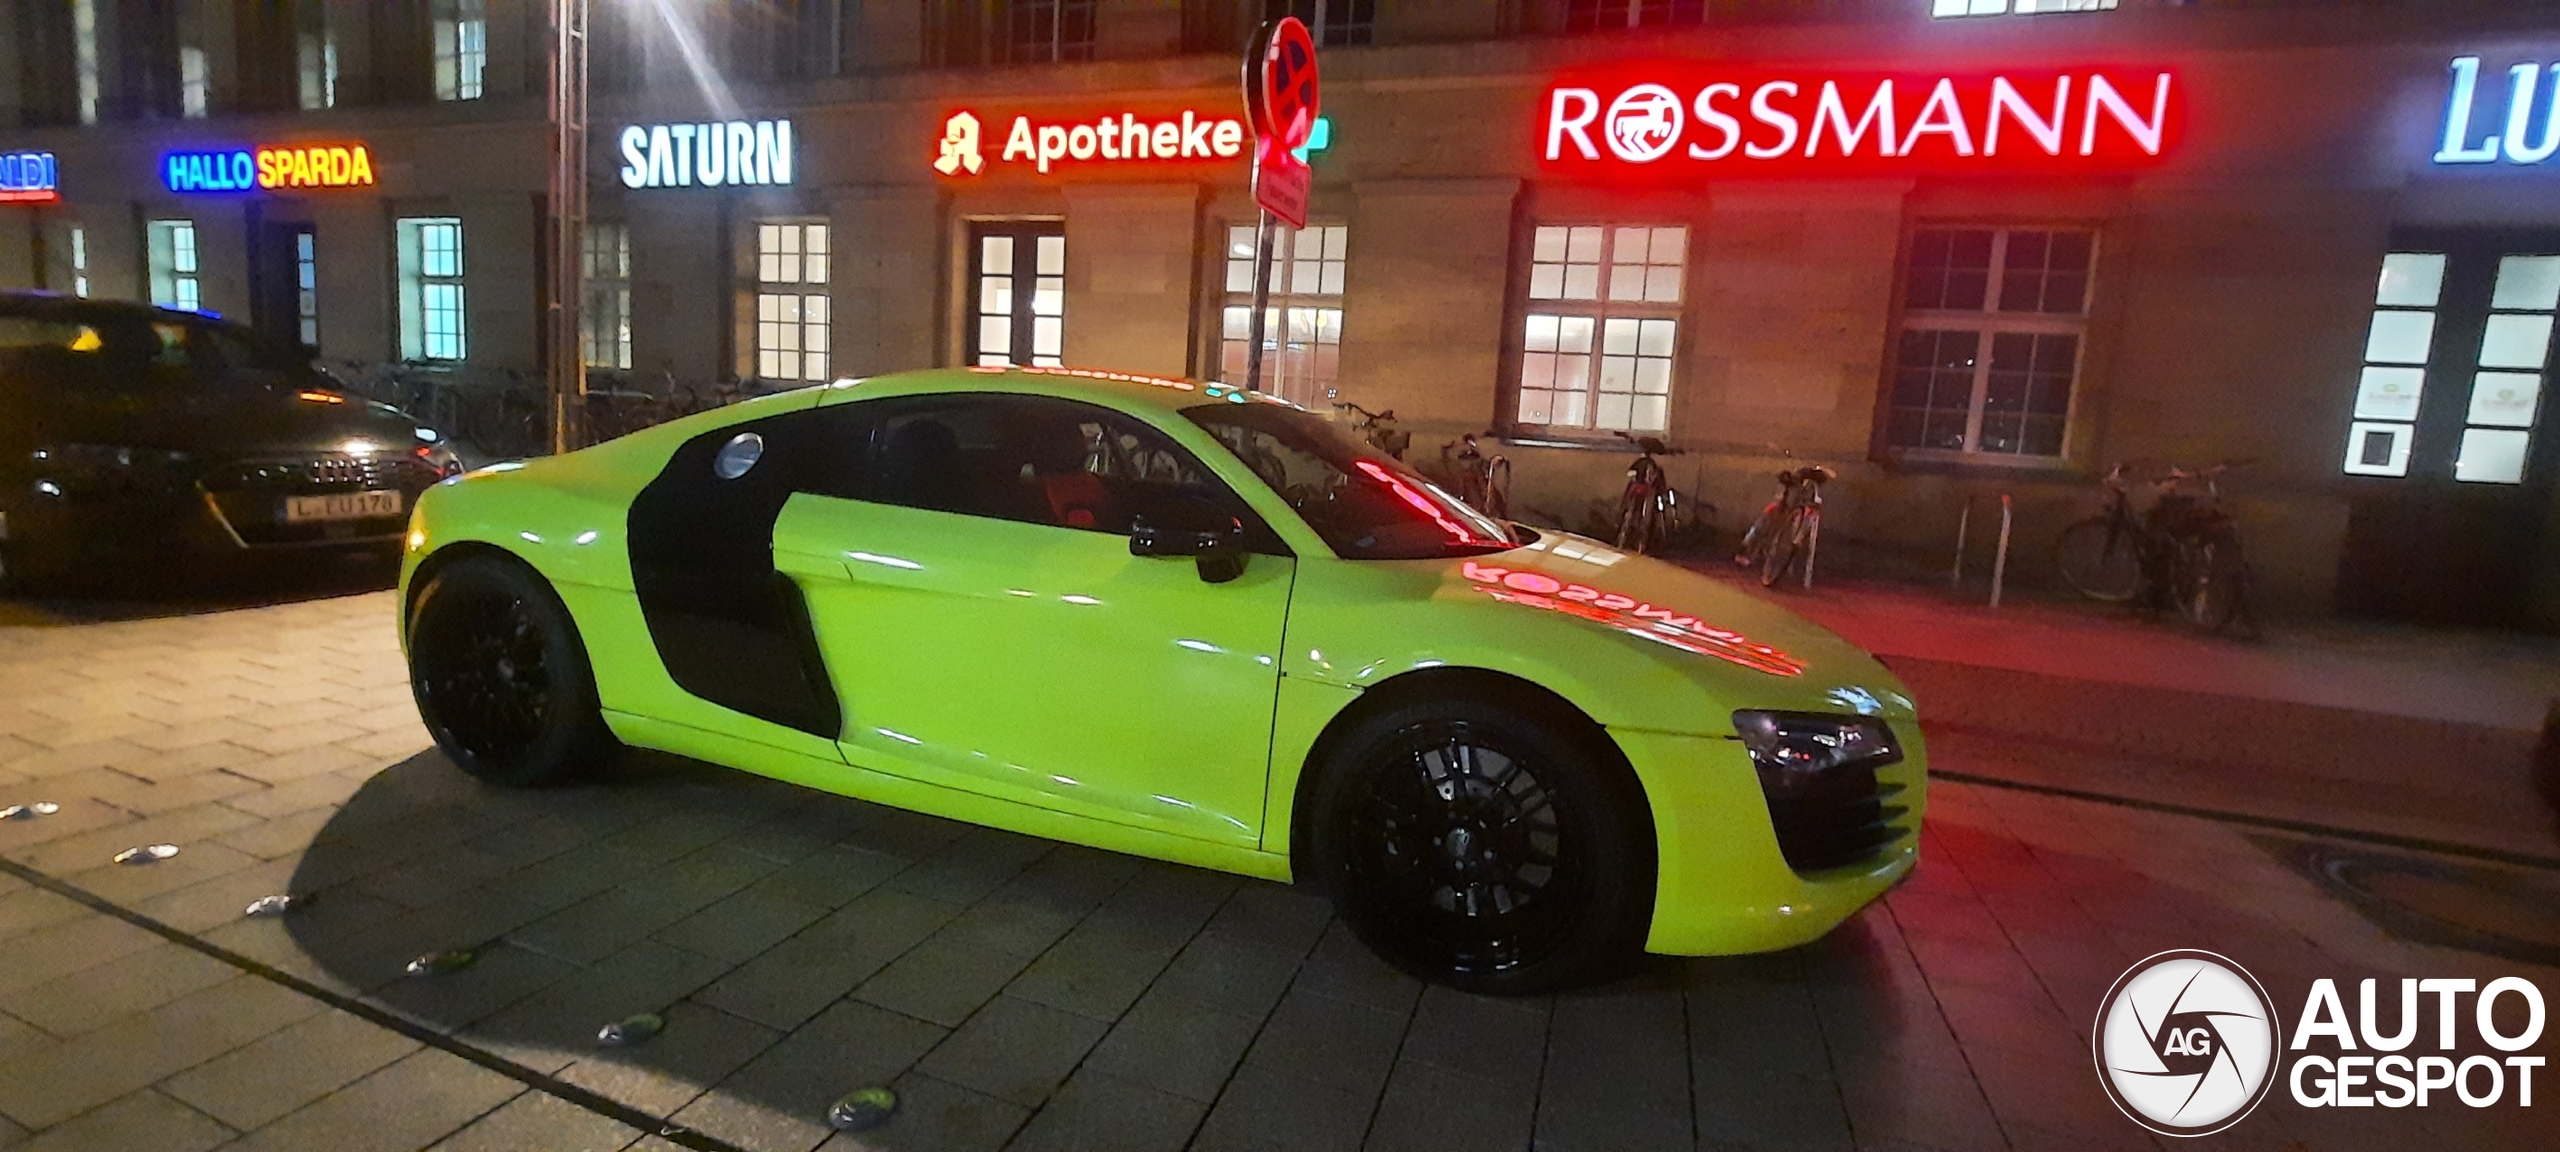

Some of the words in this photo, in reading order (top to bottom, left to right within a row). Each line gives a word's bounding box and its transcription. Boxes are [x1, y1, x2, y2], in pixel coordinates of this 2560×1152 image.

[1003, 111, 1242, 172] Apotheke
[1545, 73, 2171, 162] ROSSMANN
[0, 152, 56, 191] LDI
[168, 151, 254, 191] HALLO
[257, 146, 374, 189] SPARDA
[620, 120, 793, 189] SATURN
